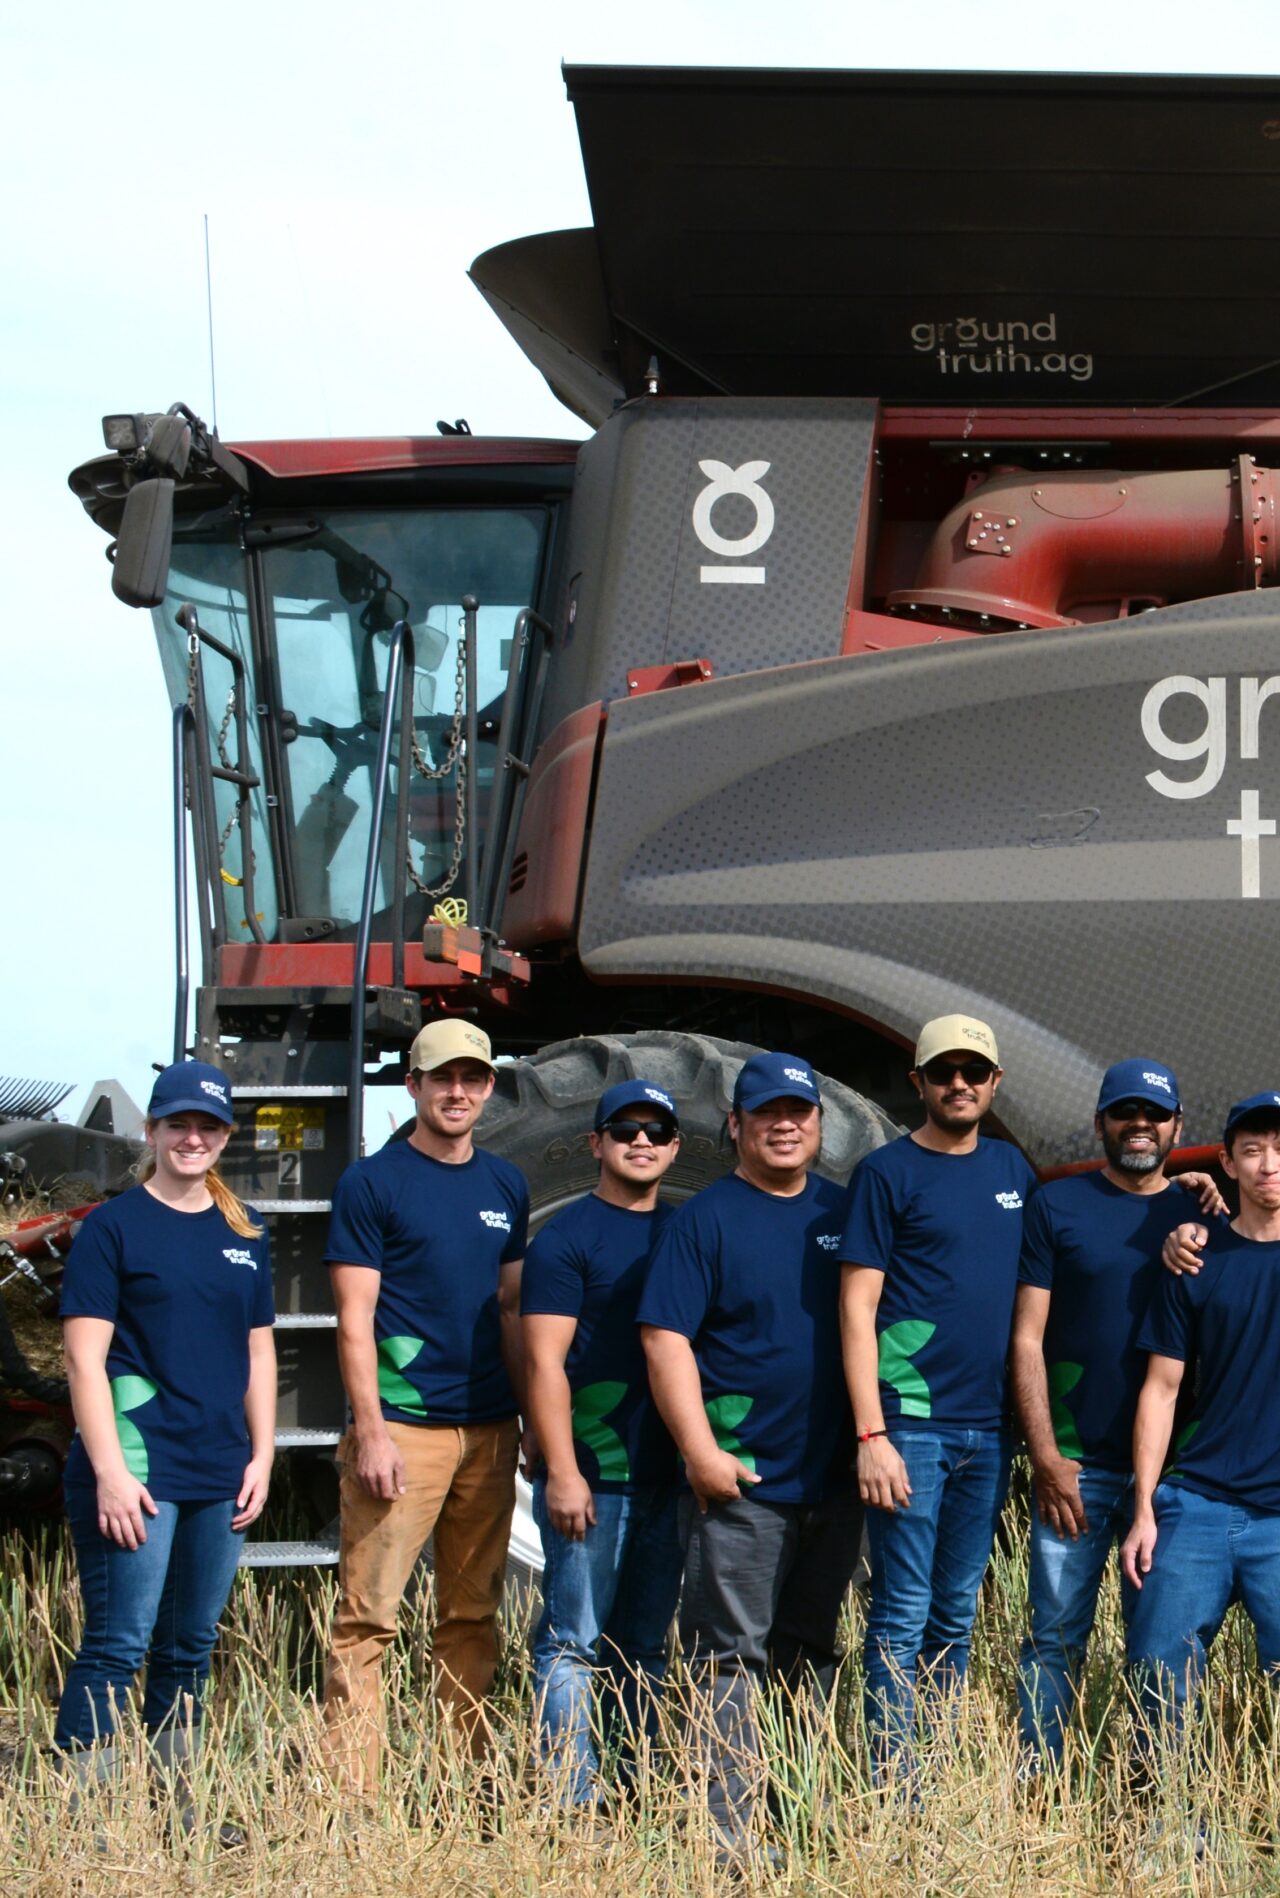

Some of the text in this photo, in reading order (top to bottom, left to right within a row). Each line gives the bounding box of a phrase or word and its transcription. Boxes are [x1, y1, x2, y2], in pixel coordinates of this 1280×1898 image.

[911, 313, 1056, 351] ground
[937, 344, 1093, 381] truth.ag
[280, 1154, 298, 1184] 2
